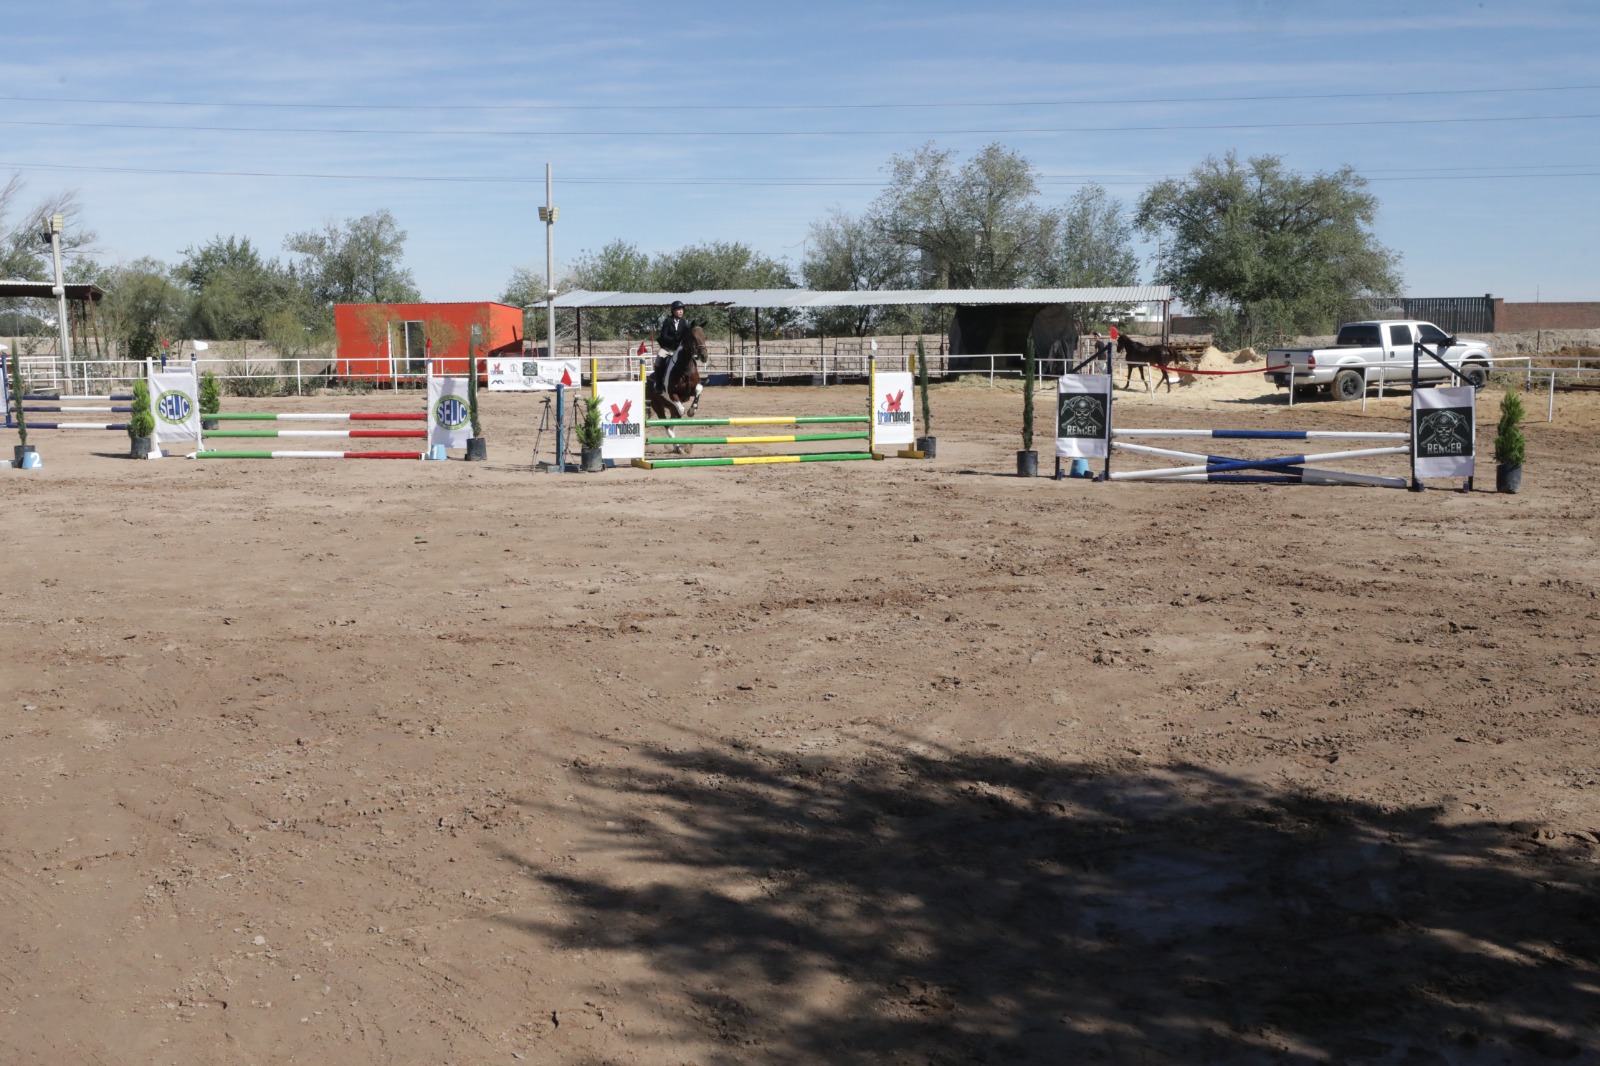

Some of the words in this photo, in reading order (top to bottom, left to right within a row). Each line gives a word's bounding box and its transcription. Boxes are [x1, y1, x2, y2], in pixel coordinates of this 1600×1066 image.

[160, 395, 189, 420] SELIC
[437, 400, 467, 426] SELIC
[31, 452, 42, 468] 2
